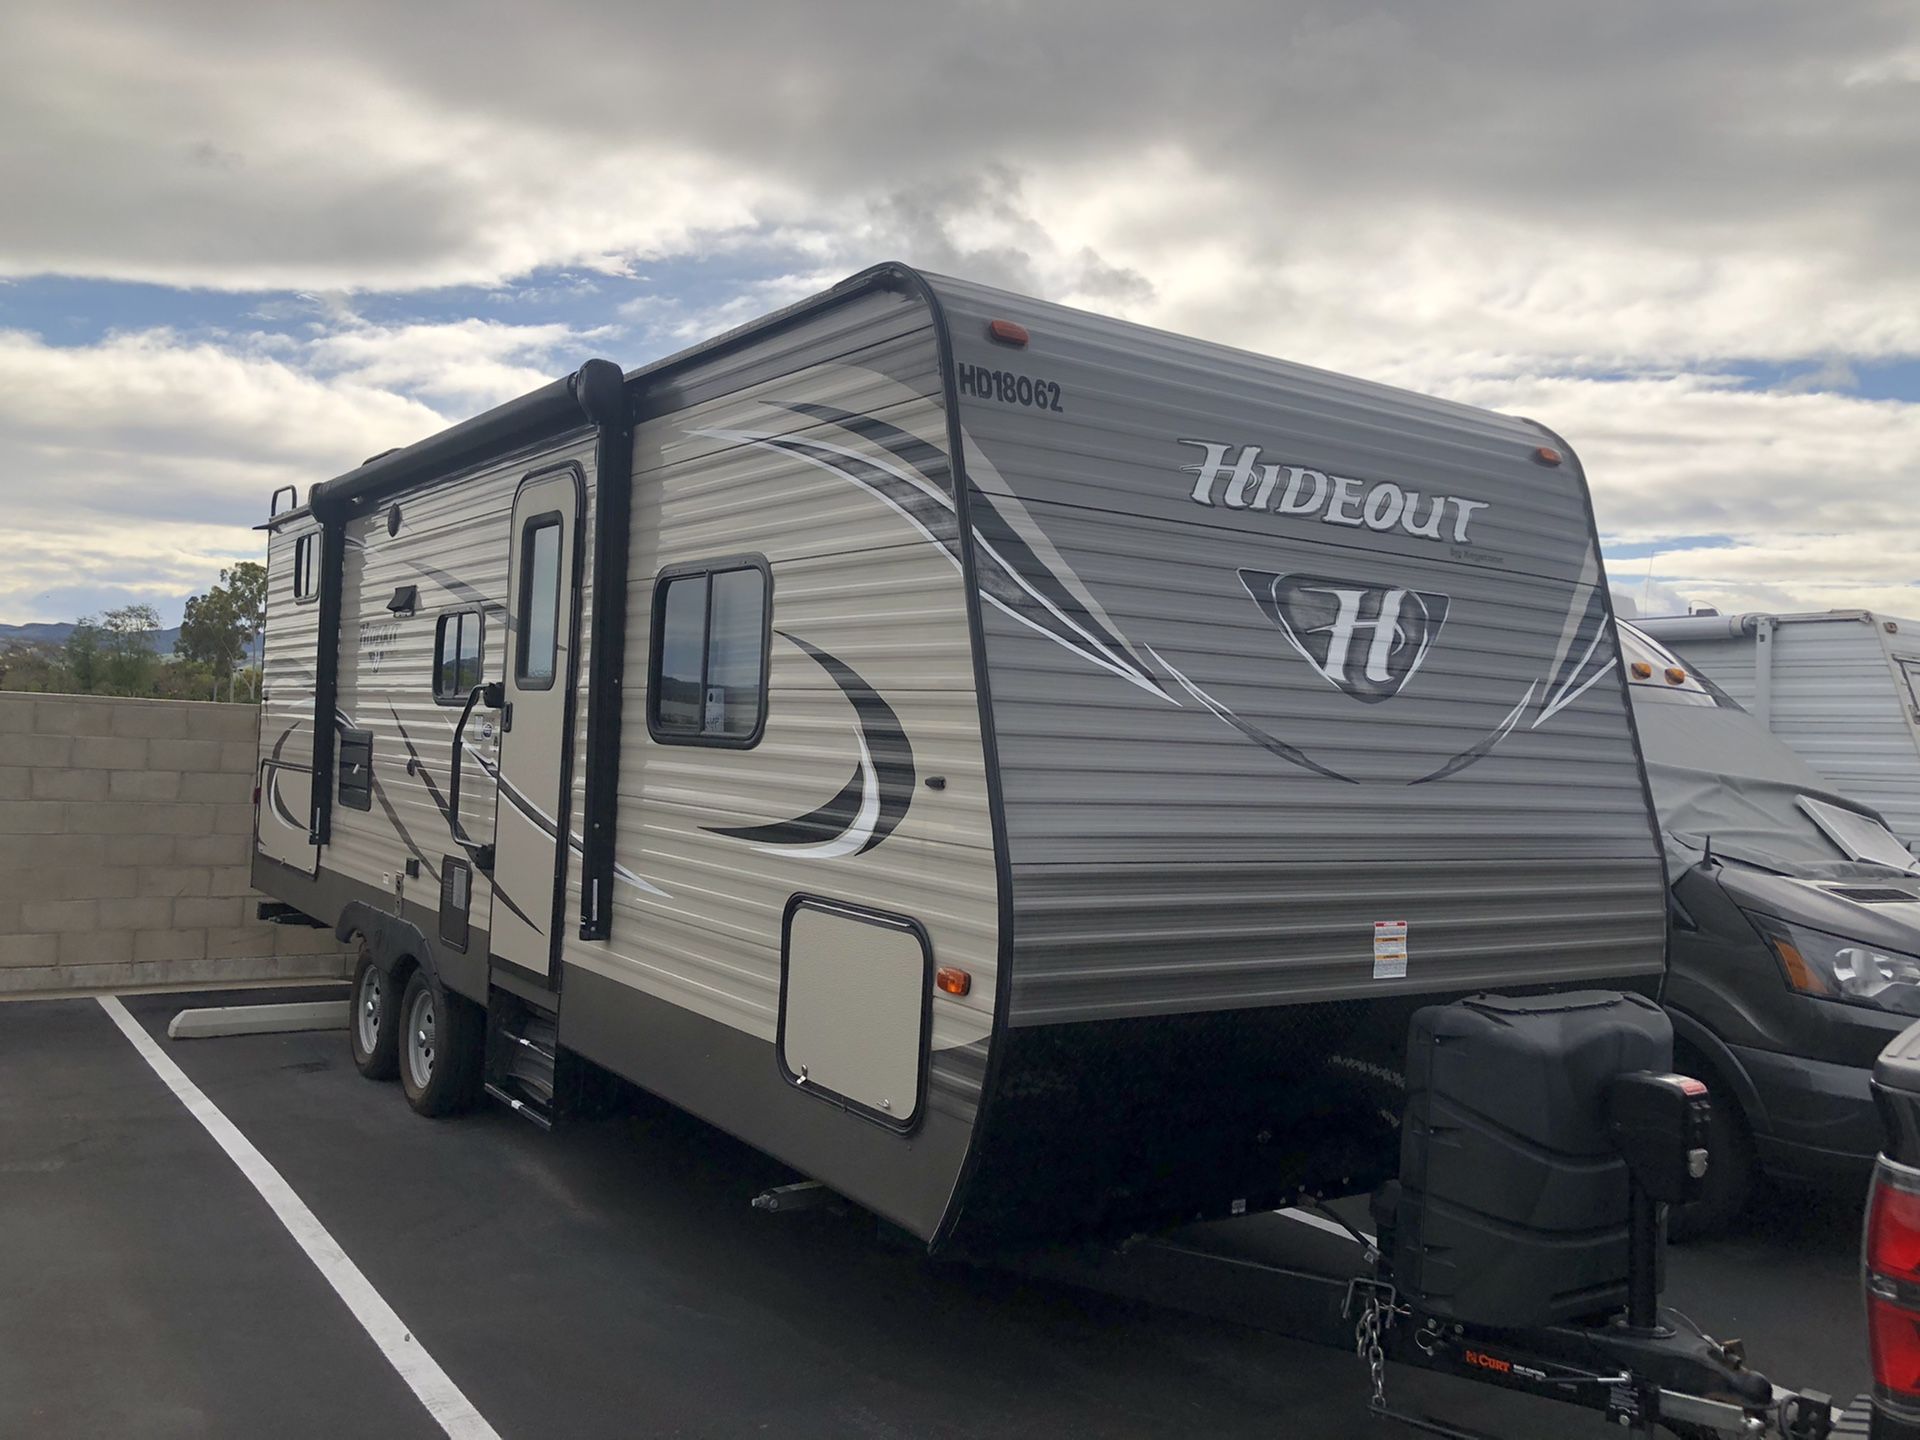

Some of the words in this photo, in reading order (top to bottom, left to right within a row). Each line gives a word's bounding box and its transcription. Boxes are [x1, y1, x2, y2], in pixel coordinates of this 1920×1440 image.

[959, 362, 1063, 413] HD18062
[1177, 438, 1490, 543] HIDEOUT
[1299, 588, 1407, 684] H
